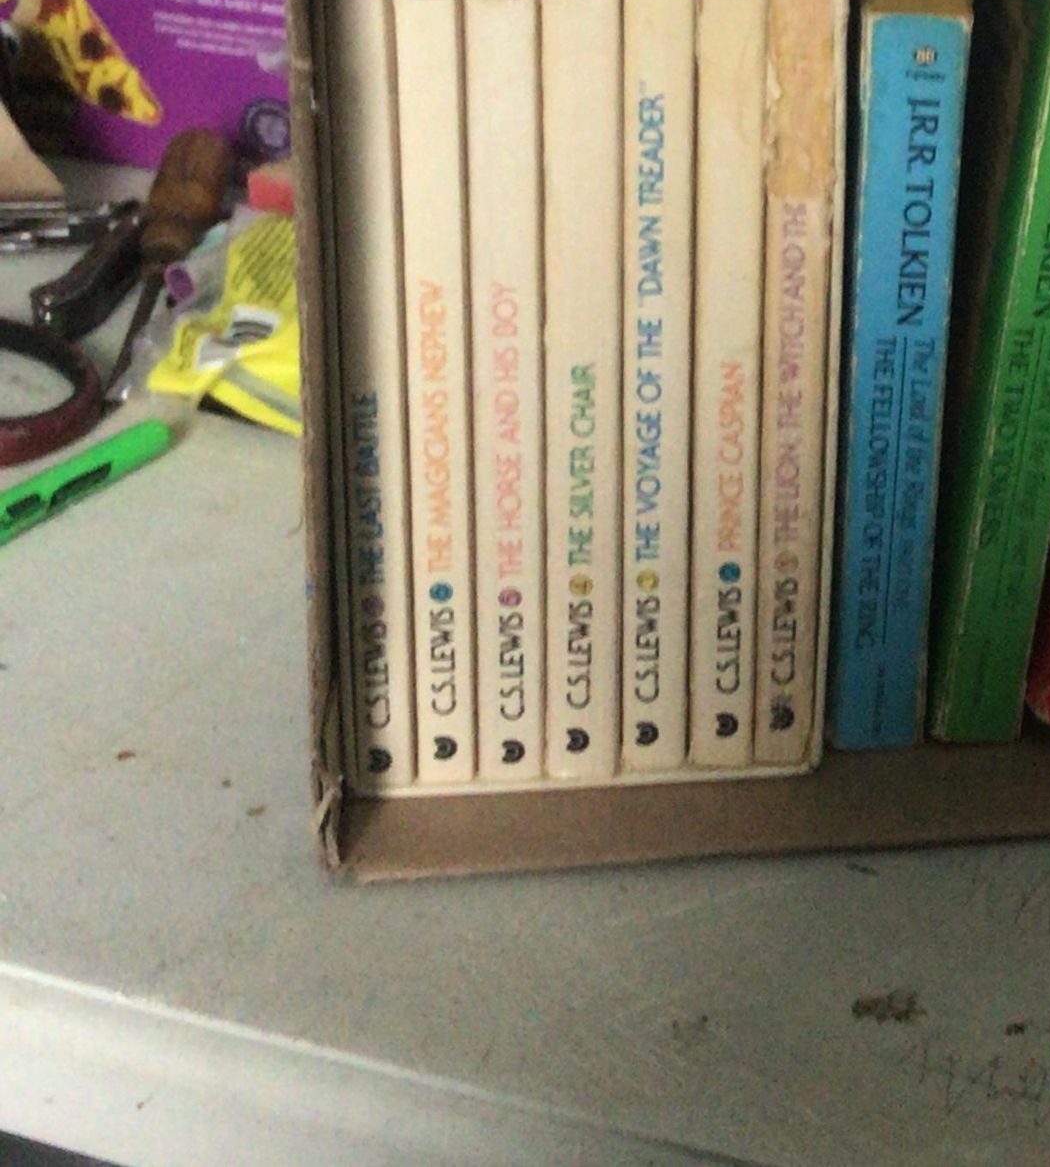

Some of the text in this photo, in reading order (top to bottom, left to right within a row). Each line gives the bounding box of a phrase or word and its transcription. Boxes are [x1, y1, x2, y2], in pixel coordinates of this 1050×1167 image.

[779, 241, 807, 300] AND
[893, 180, 934, 328] TOLKIEN
[417, 278, 448, 382] NEPHEW
[491, 284, 519, 337] BOY
[493, 347, 520, 382] HIS
[636, 317, 663, 359] THE
[871, 334, 897, 381] THE
[911, 337, 936, 374] The
[1006, 323, 1036, 379] THE
[569, 361, 596, 439] CHAIR
[635, 366, 663, 404] OF
[494, 390, 521, 444] AND
[717, 360, 745, 465] CASPIAN
[635, 409, 662, 515] VOYAGE
[862, 384, 894, 518] FELLOWSHIP
[495, 453, 523, 531] HORSE
[568, 444, 595, 519] SILVER
[716, 472, 743, 552] PRINCE
[771, 500, 800, 545] THE
[425, 533, 453, 573] THE
[496, 537, 523, 580] THE
[567, 525, 594, 567] THE
[634, 520, 660, 562] THE
